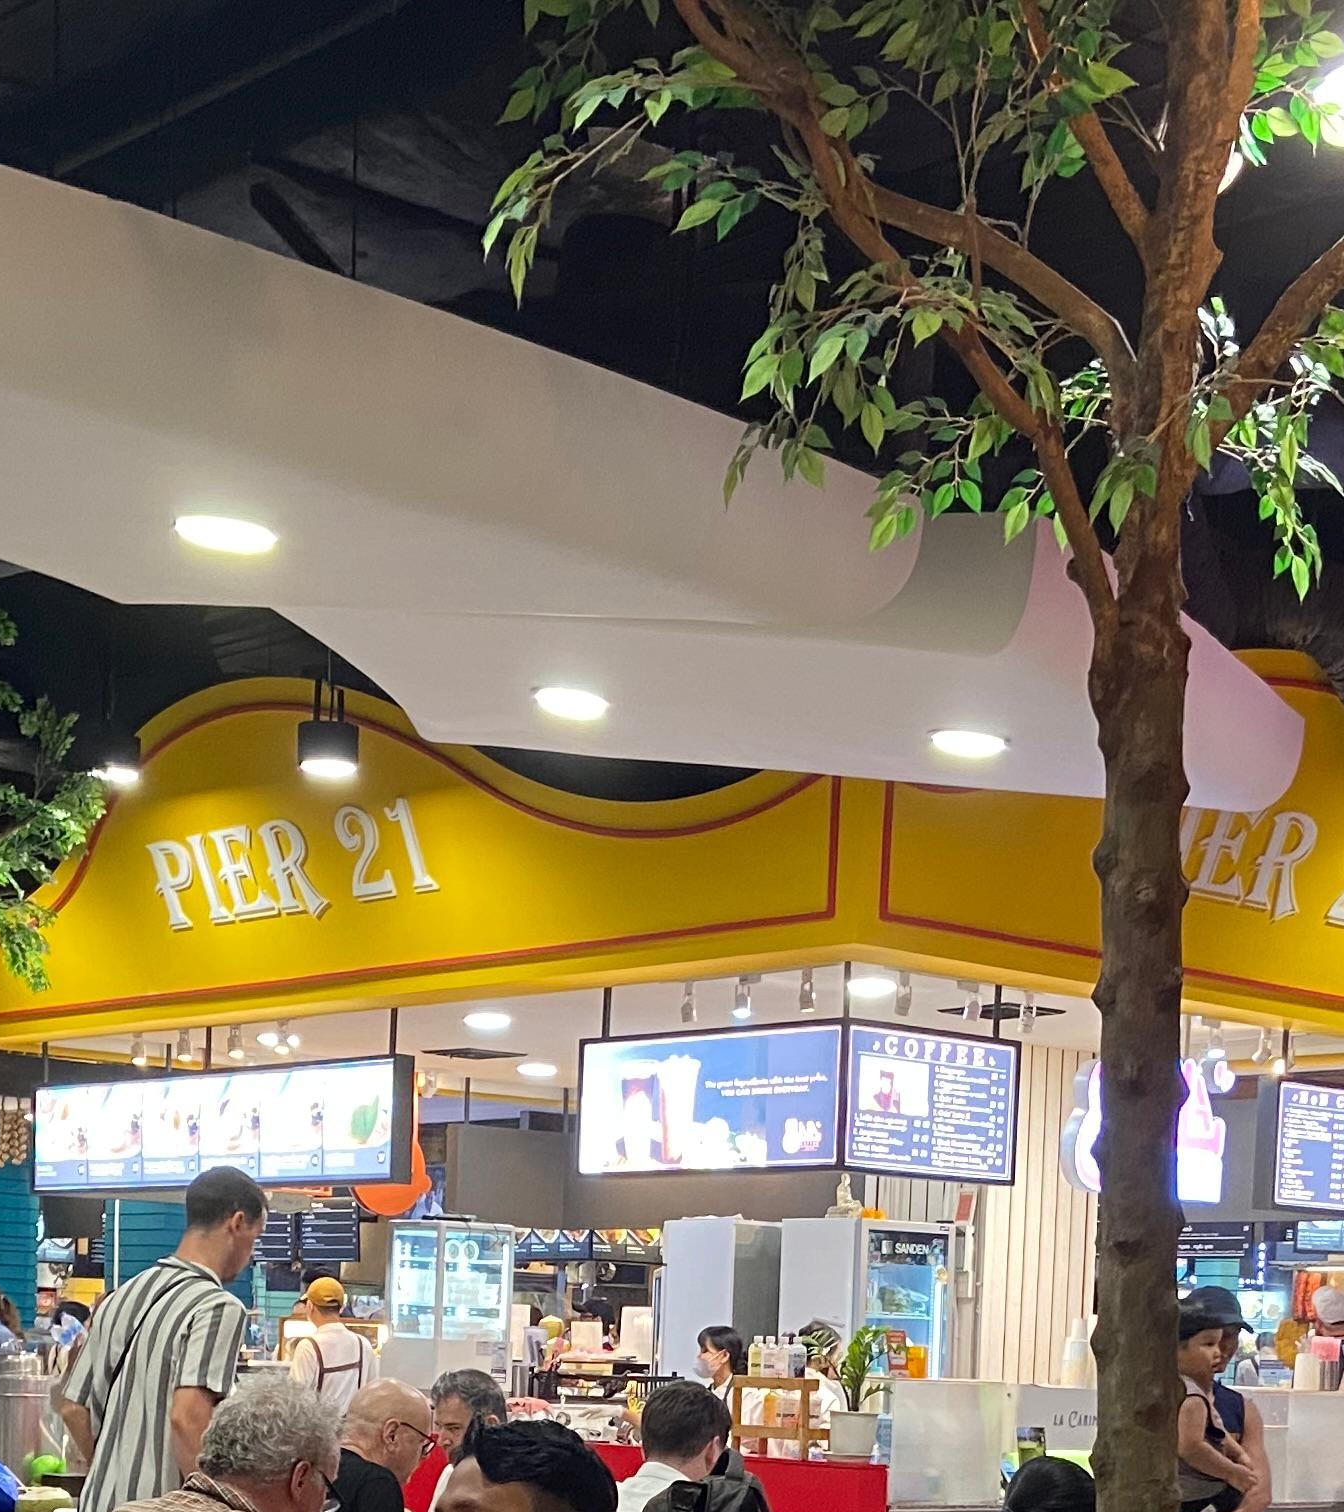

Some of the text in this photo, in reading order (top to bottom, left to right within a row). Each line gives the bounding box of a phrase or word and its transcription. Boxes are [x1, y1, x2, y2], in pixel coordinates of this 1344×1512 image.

[145, 798, 440, 932] PIER 21
[1179, 807, 1318, 923] IER
[884, 1035, 986, 1067] COFFEE
[895, 1242, 929, 1254] SANDEN
